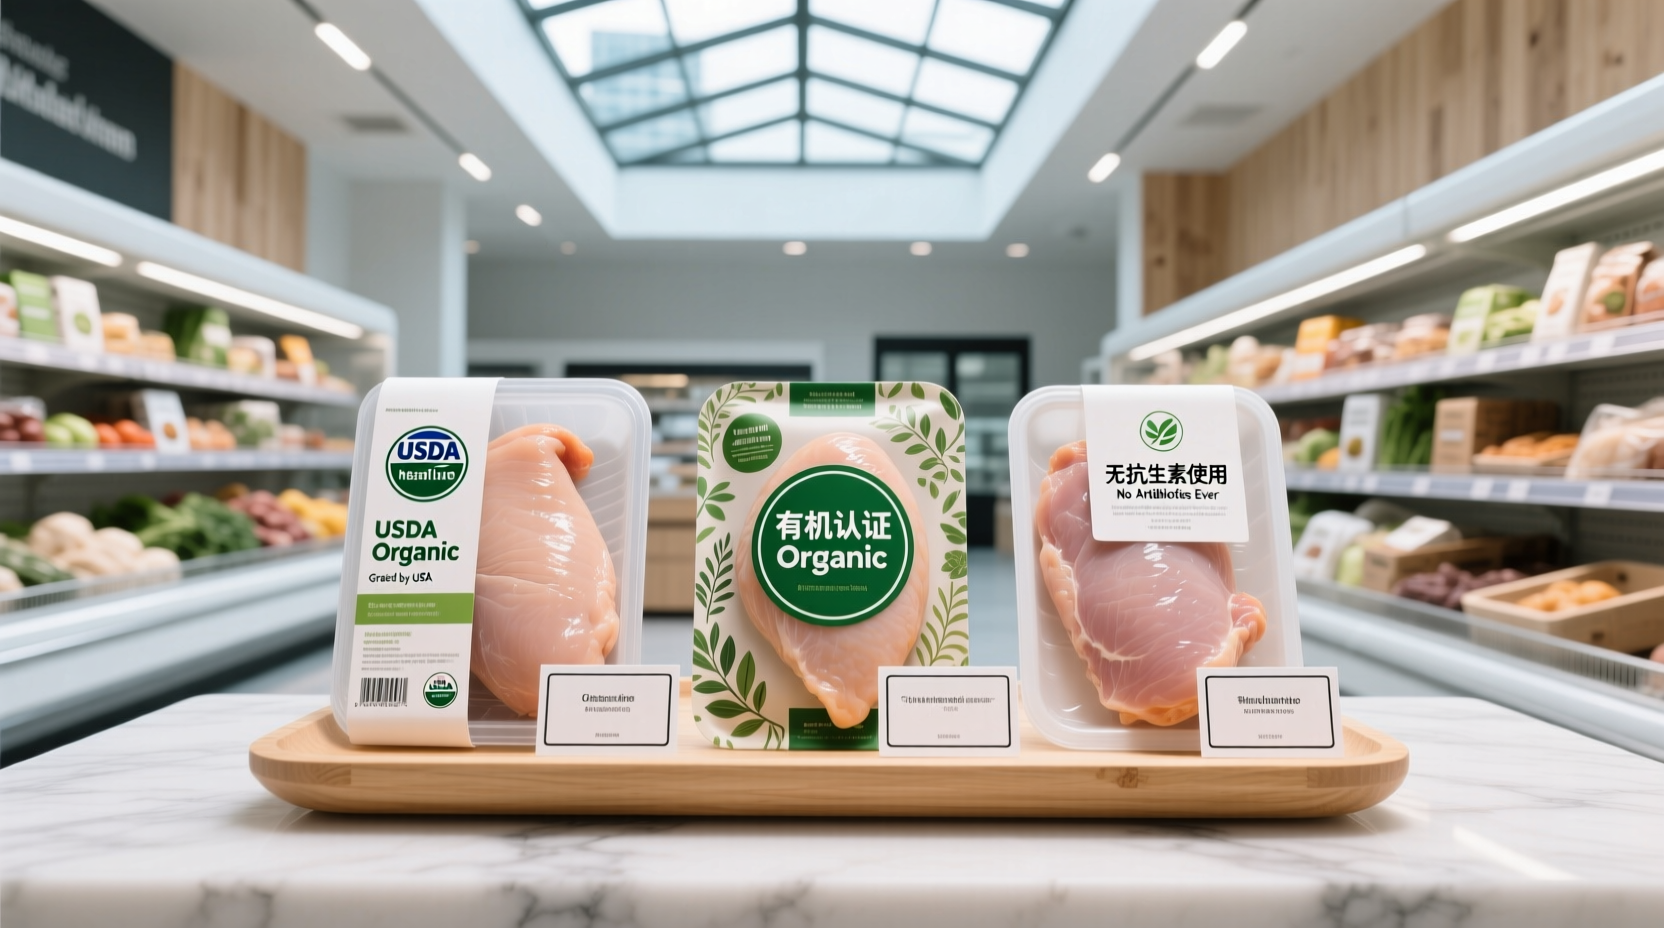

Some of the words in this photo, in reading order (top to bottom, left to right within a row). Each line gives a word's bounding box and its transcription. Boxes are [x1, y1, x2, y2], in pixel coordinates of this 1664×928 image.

[397, 441, 460, 460] USDA
[1106, 463, 1227, 485] 无抗生素使用
[1117, 488, 1132, 500] No
[1195, 489, 1219, 500] Ever
[375, 520, 438, 539] USDA
[775, 510, 892, 540] 有机认证
[372, 541, 460, 567] Organic
[776, 544, 888, 576] Organic
[399, 572, 410, 586] by
[412, 571, 433, 583] USA
